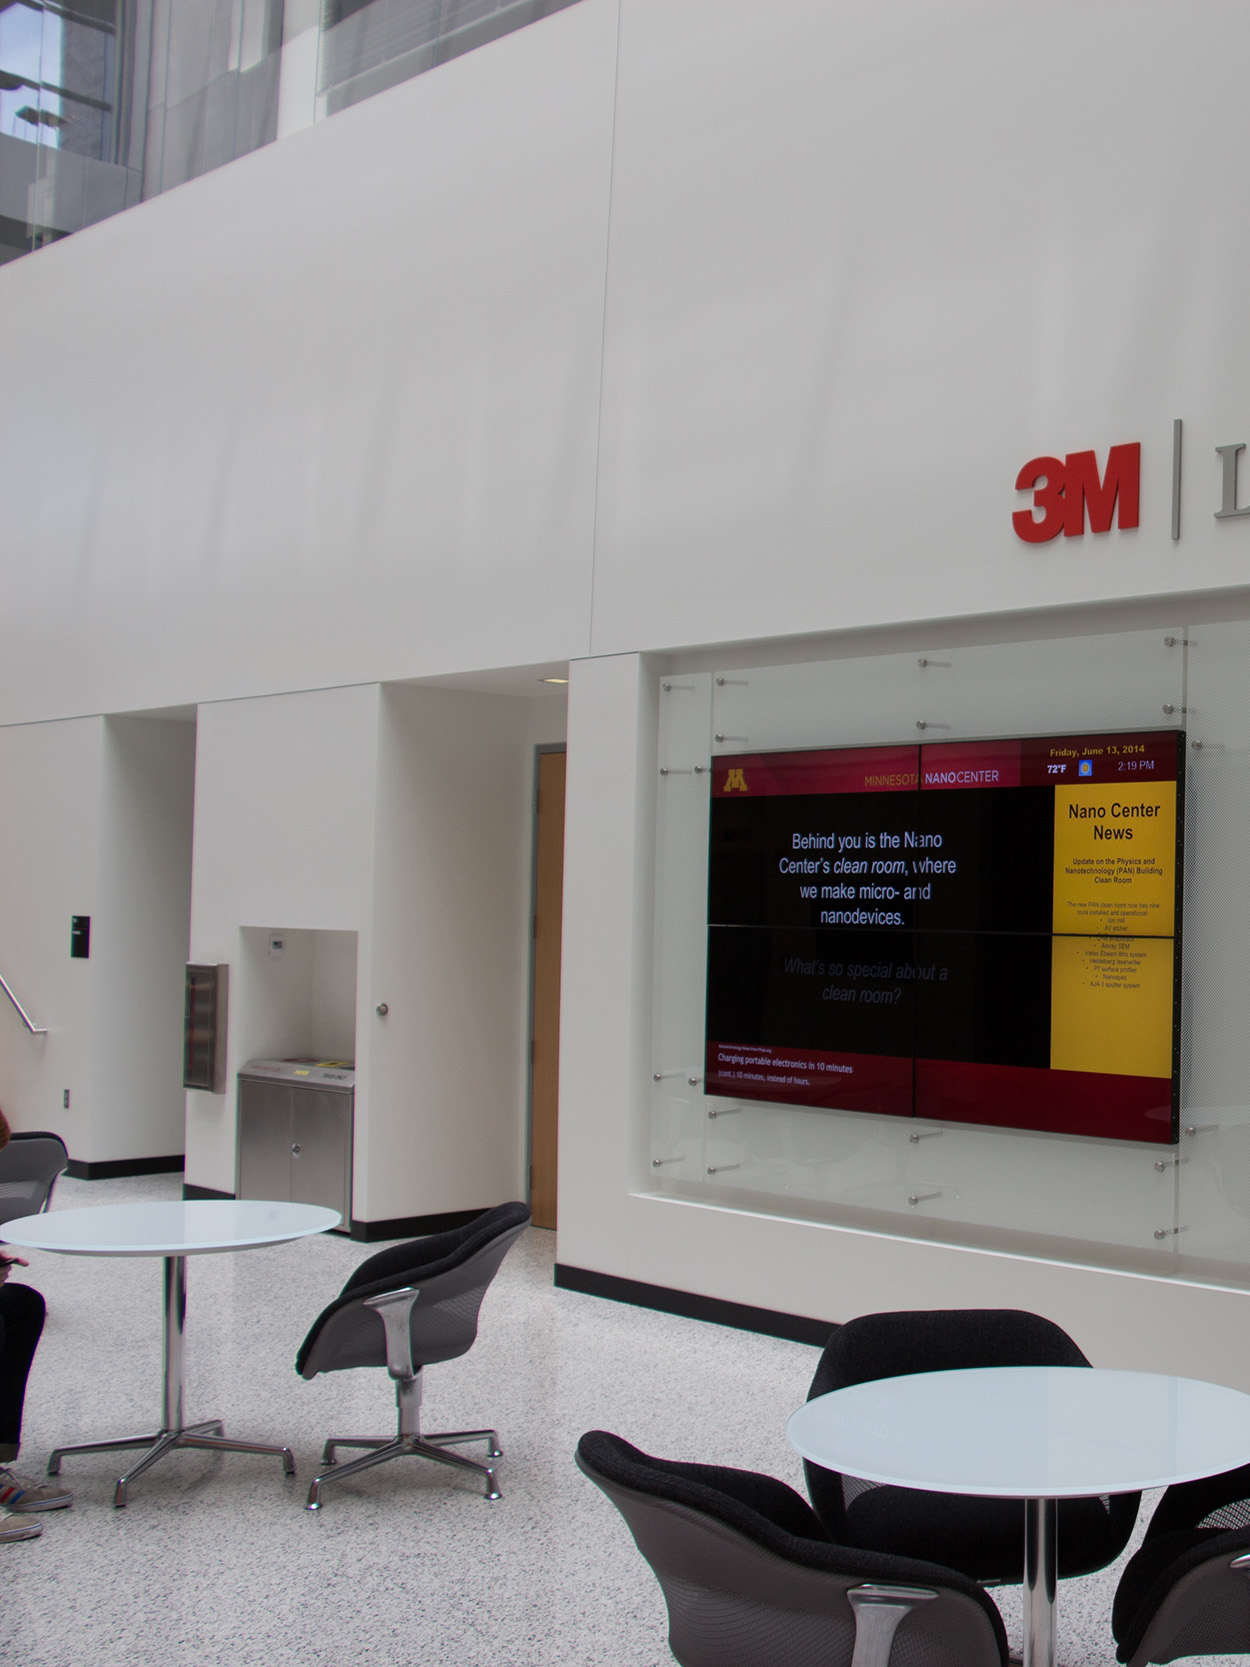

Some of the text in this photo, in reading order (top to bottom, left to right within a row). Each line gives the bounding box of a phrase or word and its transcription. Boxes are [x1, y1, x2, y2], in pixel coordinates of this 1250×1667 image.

[1012, 441, 1141, 544] 3M
[1050, 749, 1079, 757] Friday,
[1106, 746, 1120, 755] 13,
[1122, 745, 1145, 753] 2014
[1047, 764, 1067, 774] 72°F
[1118, 760, 1154, 771] 2:19 PM
[864, 770, 999, 786] MINNESOTA NANOCENTER
[1069, 803, 1160, 818] Nano Center
[1094, 825, 1133, 840] News
[792, 832, 942, 852] Behind you is the Nano
[779, 858, 956, 875] Center's clean room, where
[1094, 876, 1133, 884] Clean Room
[800, 884, 930, 900] we make micro- and
[821, 909, 904, 925] nanodevices.
[784, 959, 824, 974] What's
[828, 962, 842, 975] so
[847, 962, 892, 980] special
[939, 968, 948, 981] a
[822, 985, 902, 1004] clean room?
[718, 1053, 853, 1074] Charging portable electronics in 10 minutes
